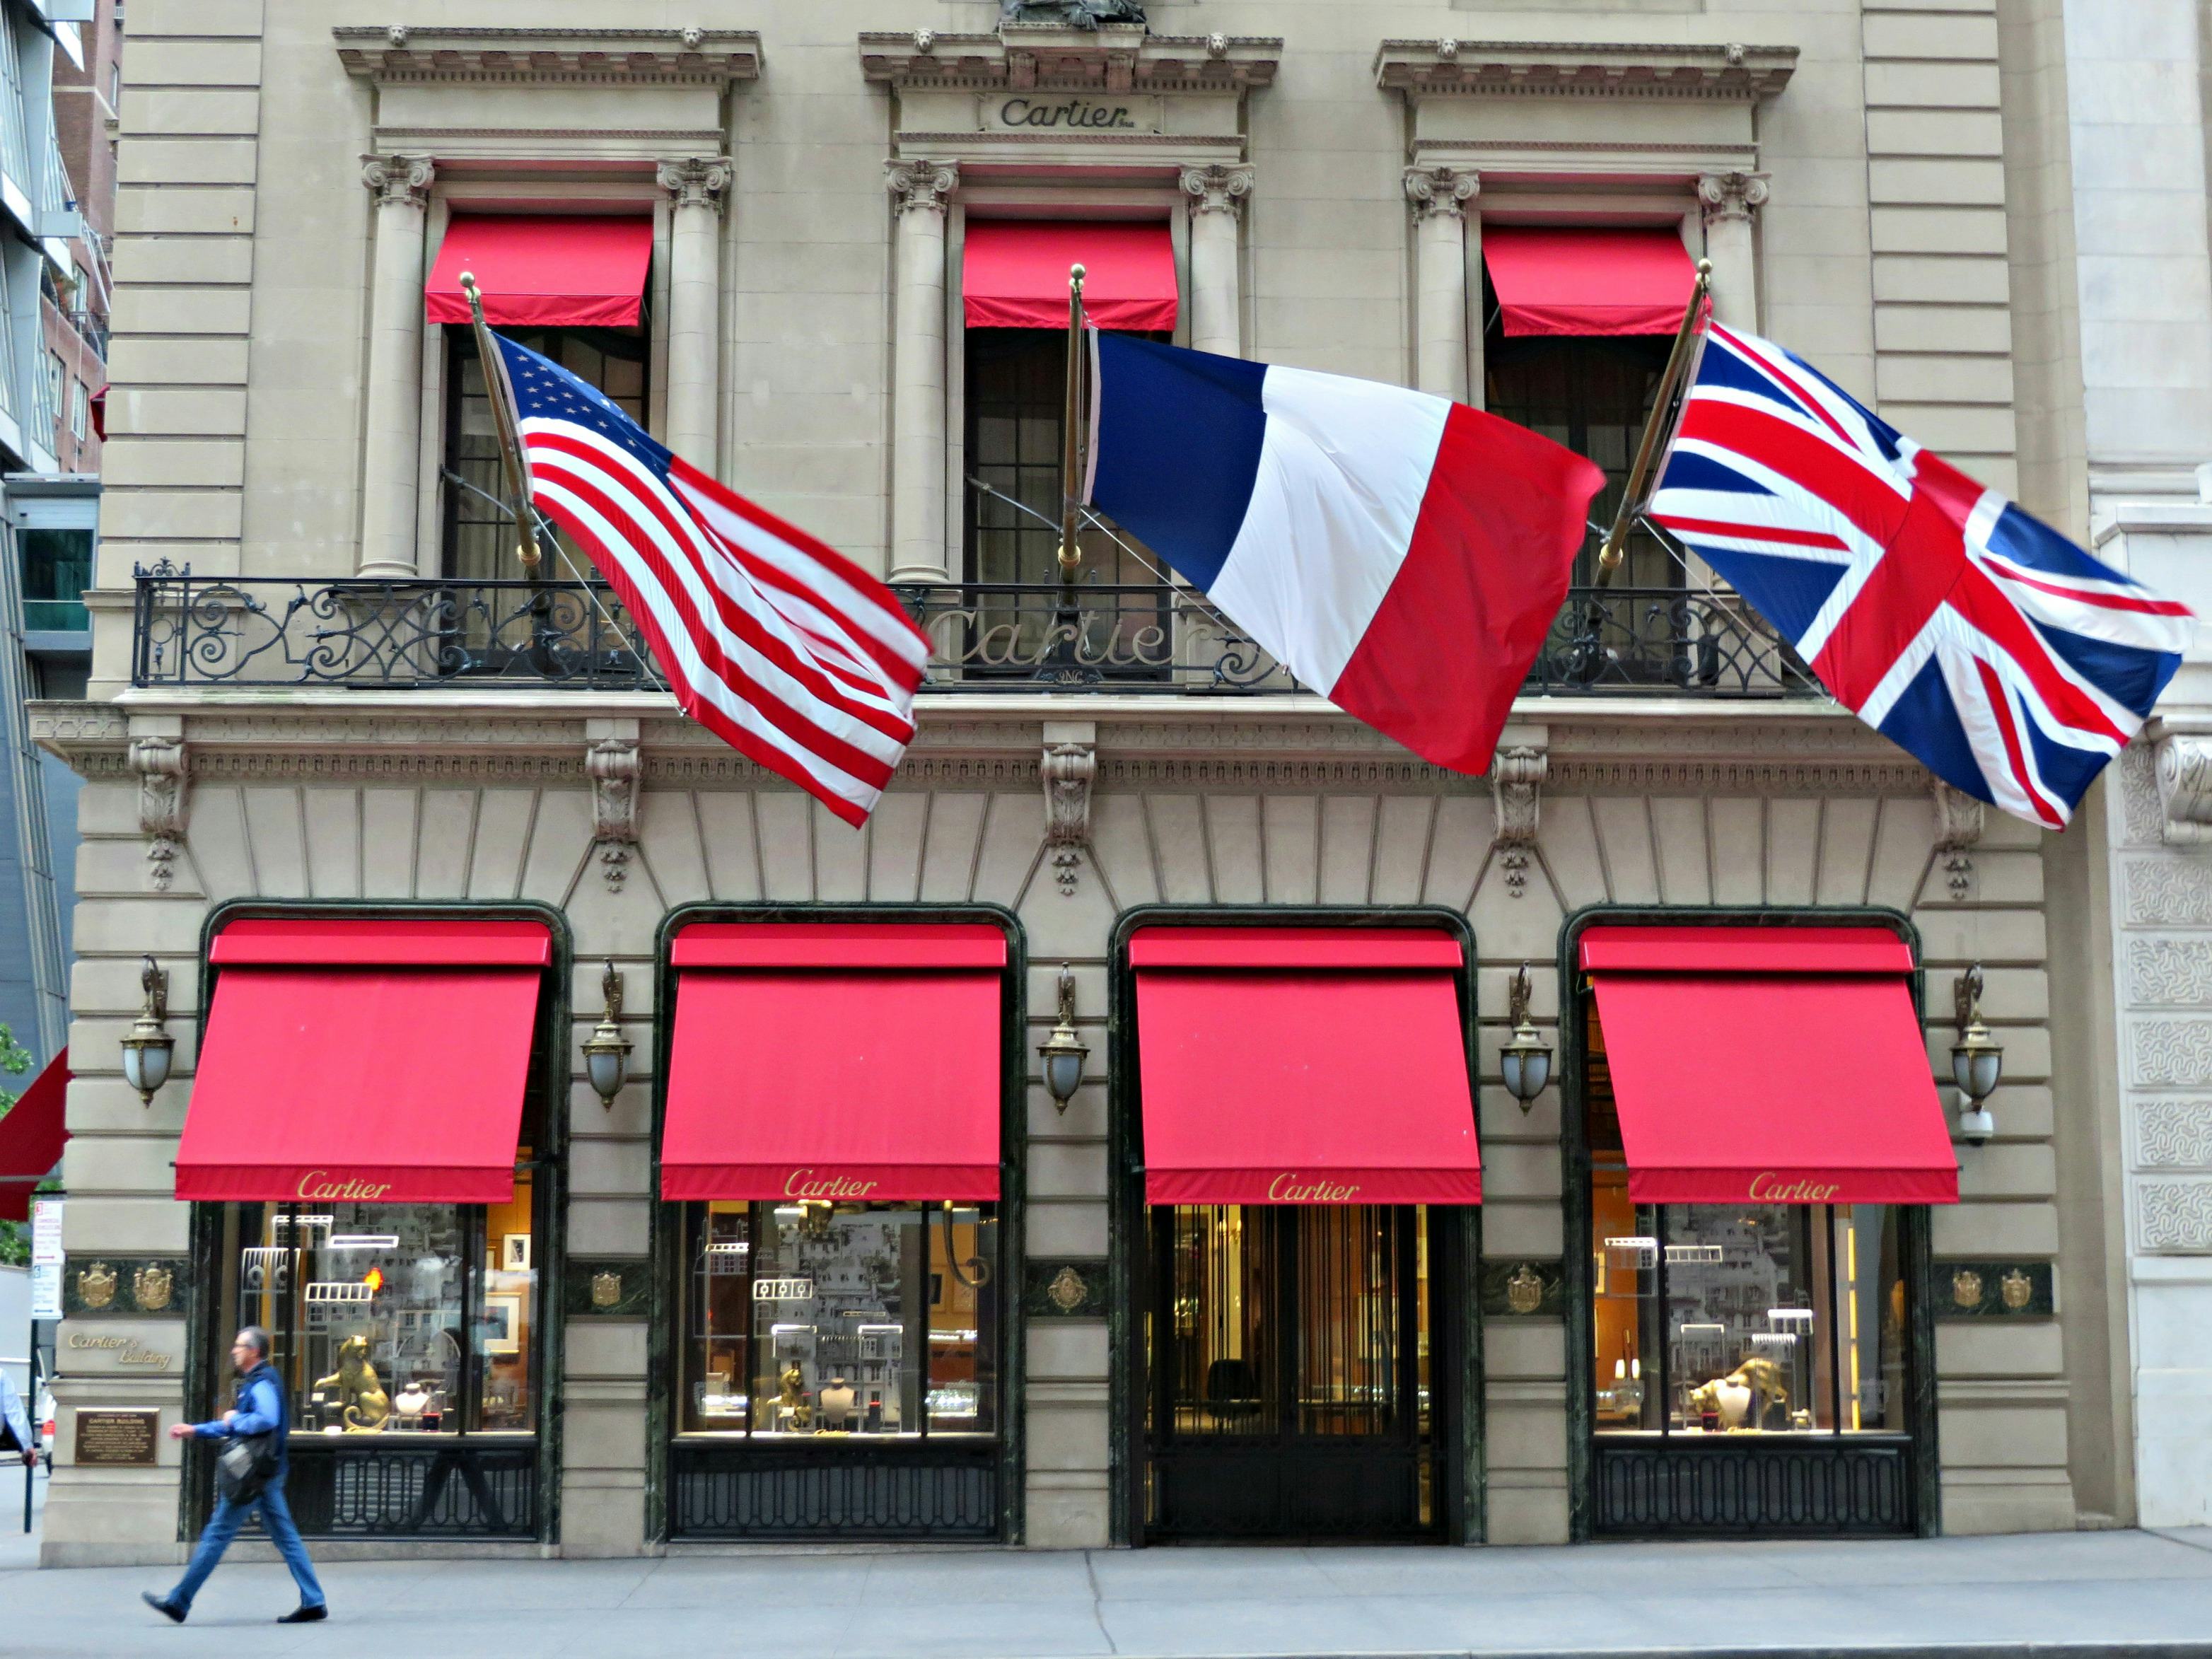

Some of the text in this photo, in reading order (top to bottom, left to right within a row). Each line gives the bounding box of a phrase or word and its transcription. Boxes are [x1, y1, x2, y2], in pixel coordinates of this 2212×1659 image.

[1001, 98, 1128, 128] Cartier
[927, 610, 1213, 666] Cartier
[297, 1170, 391, 1199] Cartier
[784, 1168, 878, 1197] Cartier
[1267, 1172, 1361, 1201] Cartier
[1749, 1171, 1840, 1200] Cartier
